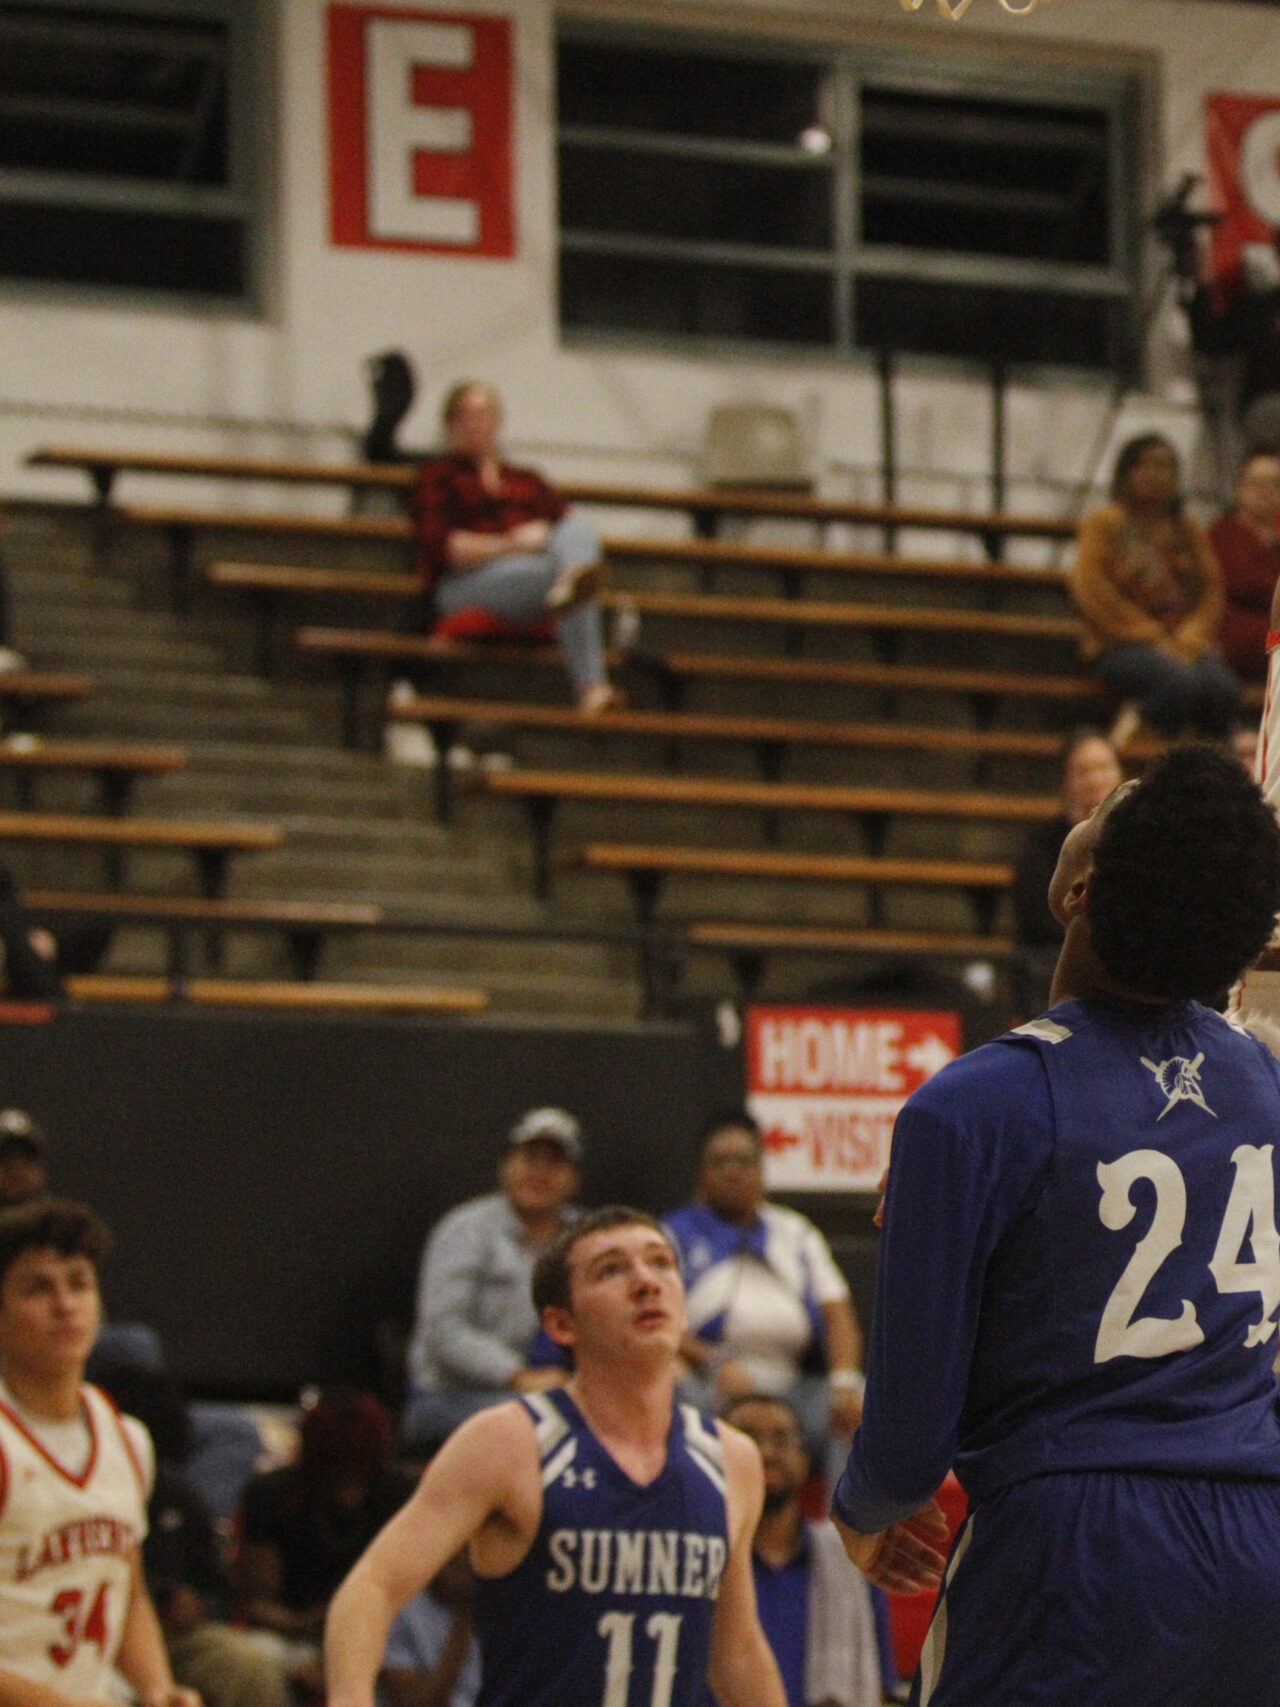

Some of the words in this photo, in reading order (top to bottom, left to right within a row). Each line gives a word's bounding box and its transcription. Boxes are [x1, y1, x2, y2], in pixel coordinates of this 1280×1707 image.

[365, 19, 480, 244] E
[760, 1018, 904, 1091] HOME
[547, 1528, 727, 1601] SUMNER
[50, 1579, 109, 1670] 34
[597, 1611, 684, 1707] 11
